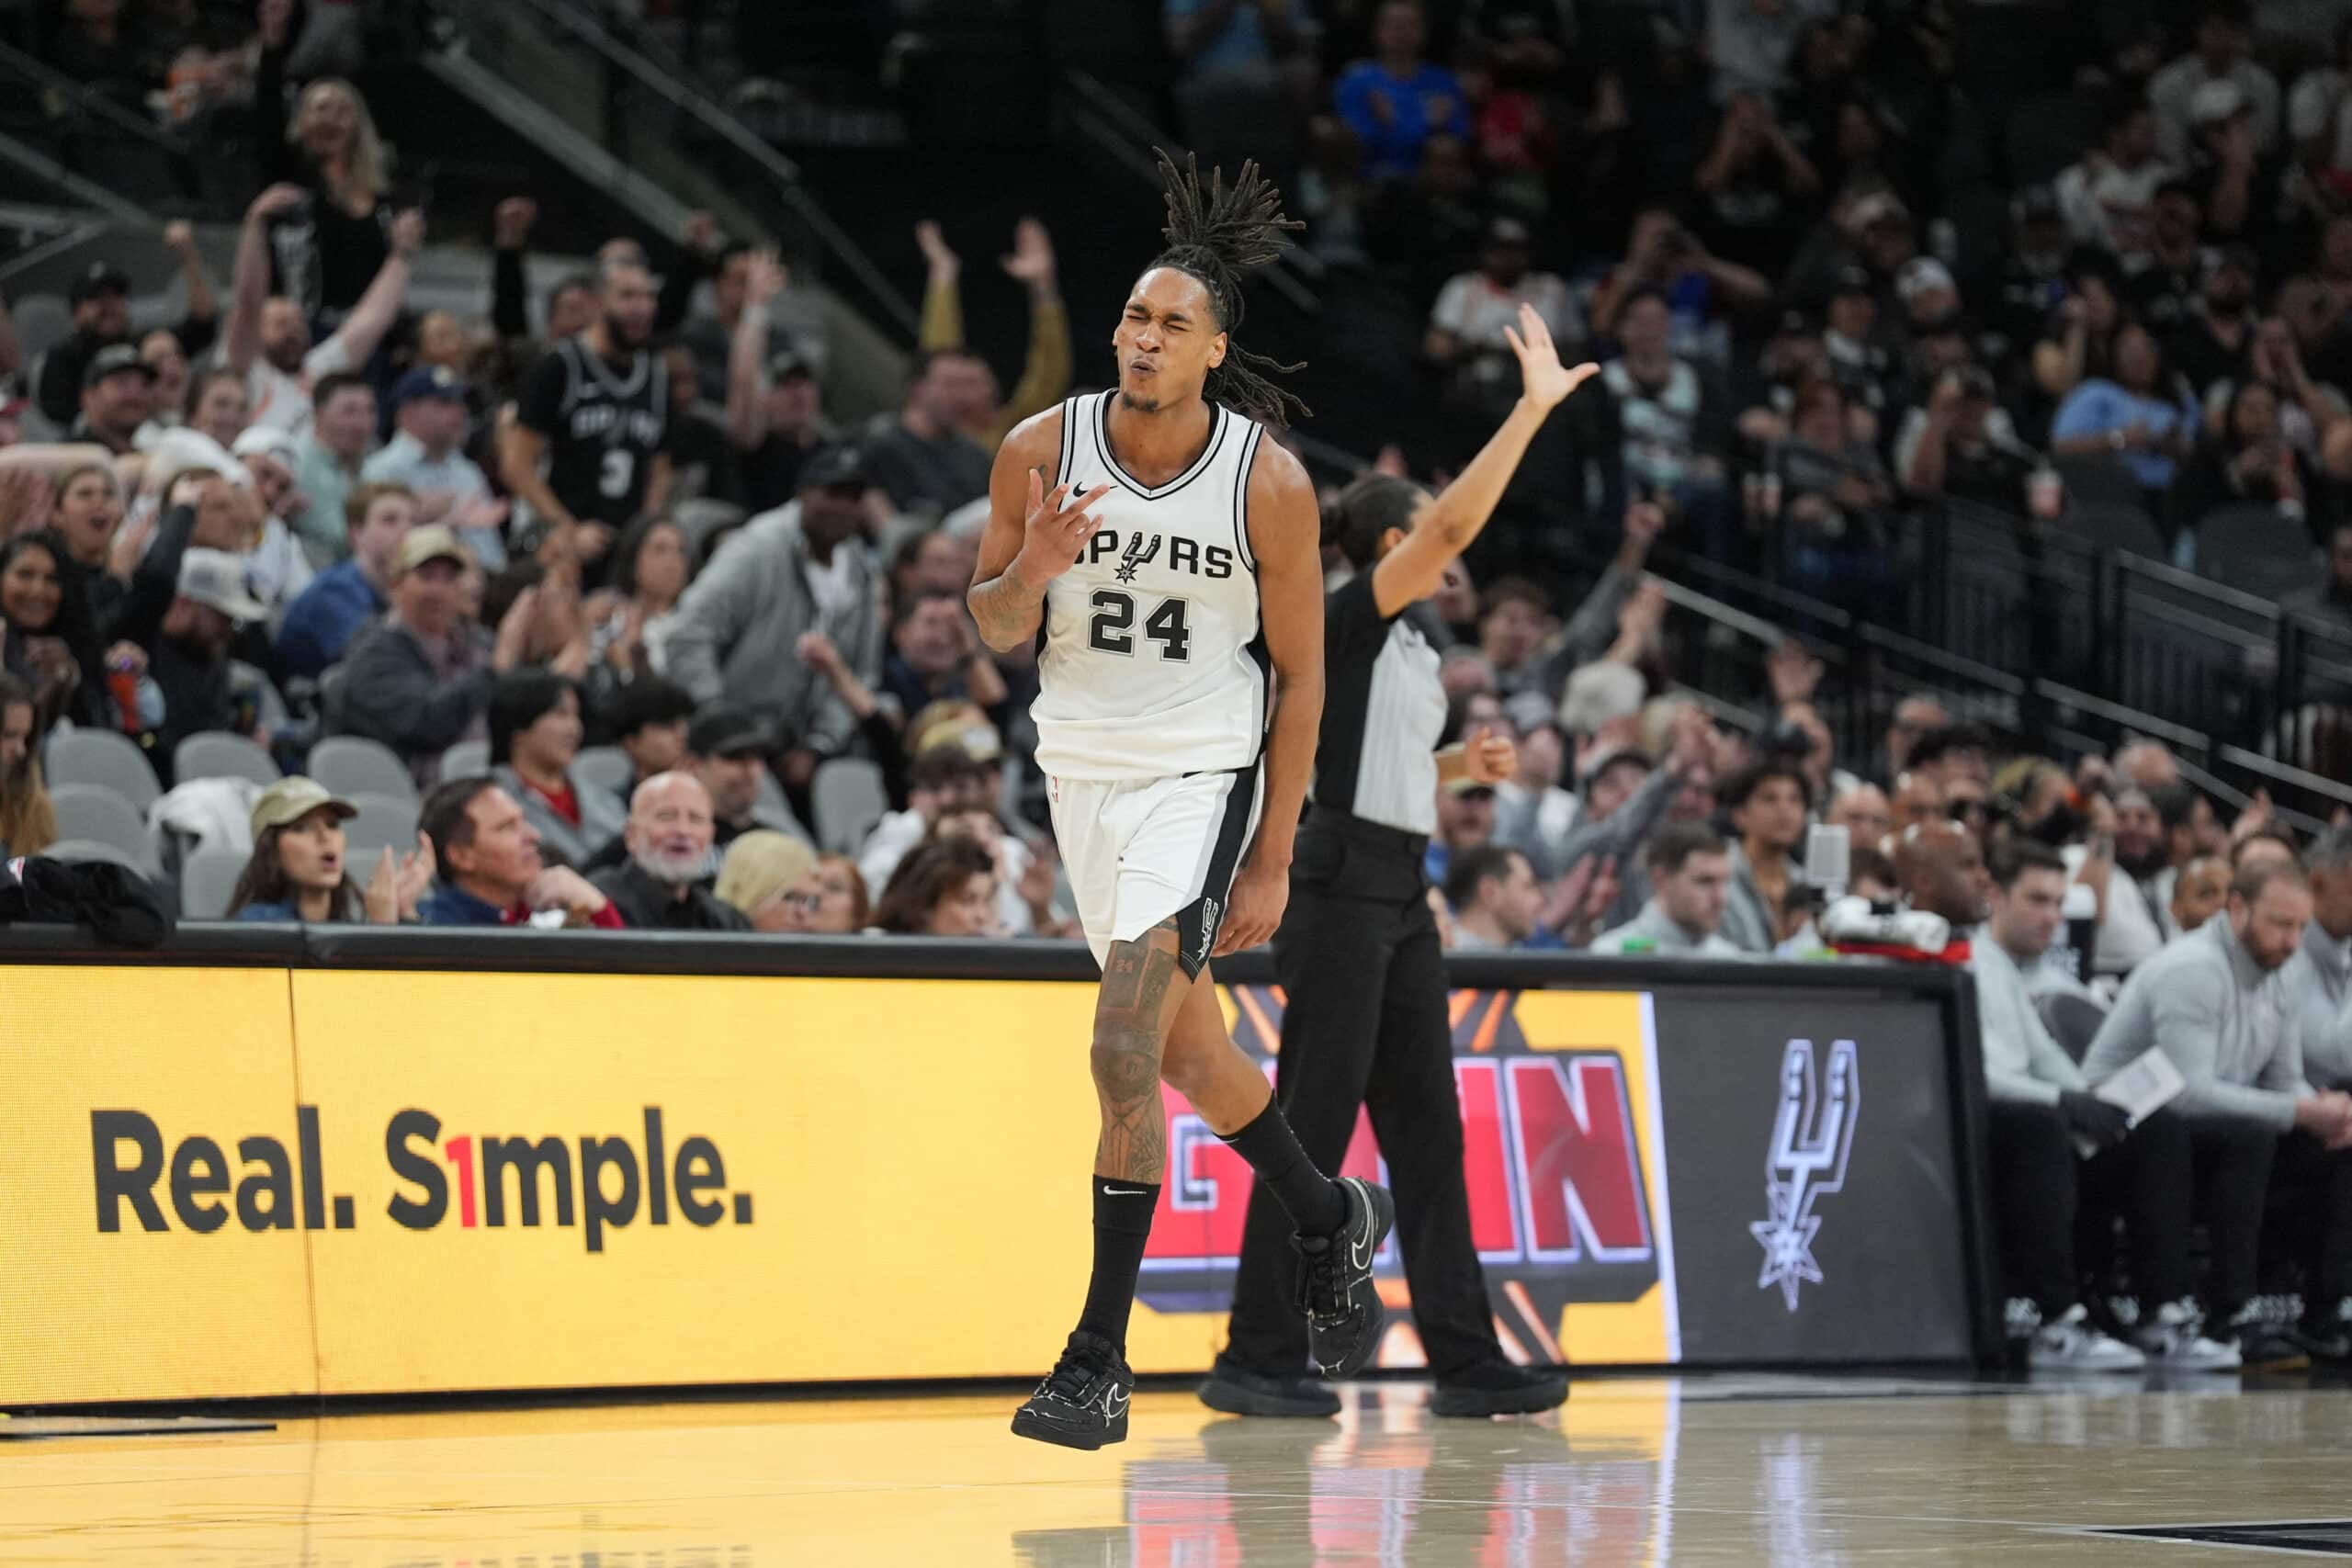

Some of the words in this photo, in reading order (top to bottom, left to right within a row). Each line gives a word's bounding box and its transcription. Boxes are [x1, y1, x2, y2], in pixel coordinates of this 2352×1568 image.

[1073, 530, 1233, 584] PURS
[1088, 587, 1193, 663] 24
[91, 1105, 356, 1235] Real.
[386, 1105, 755, 1254] S1mple.
